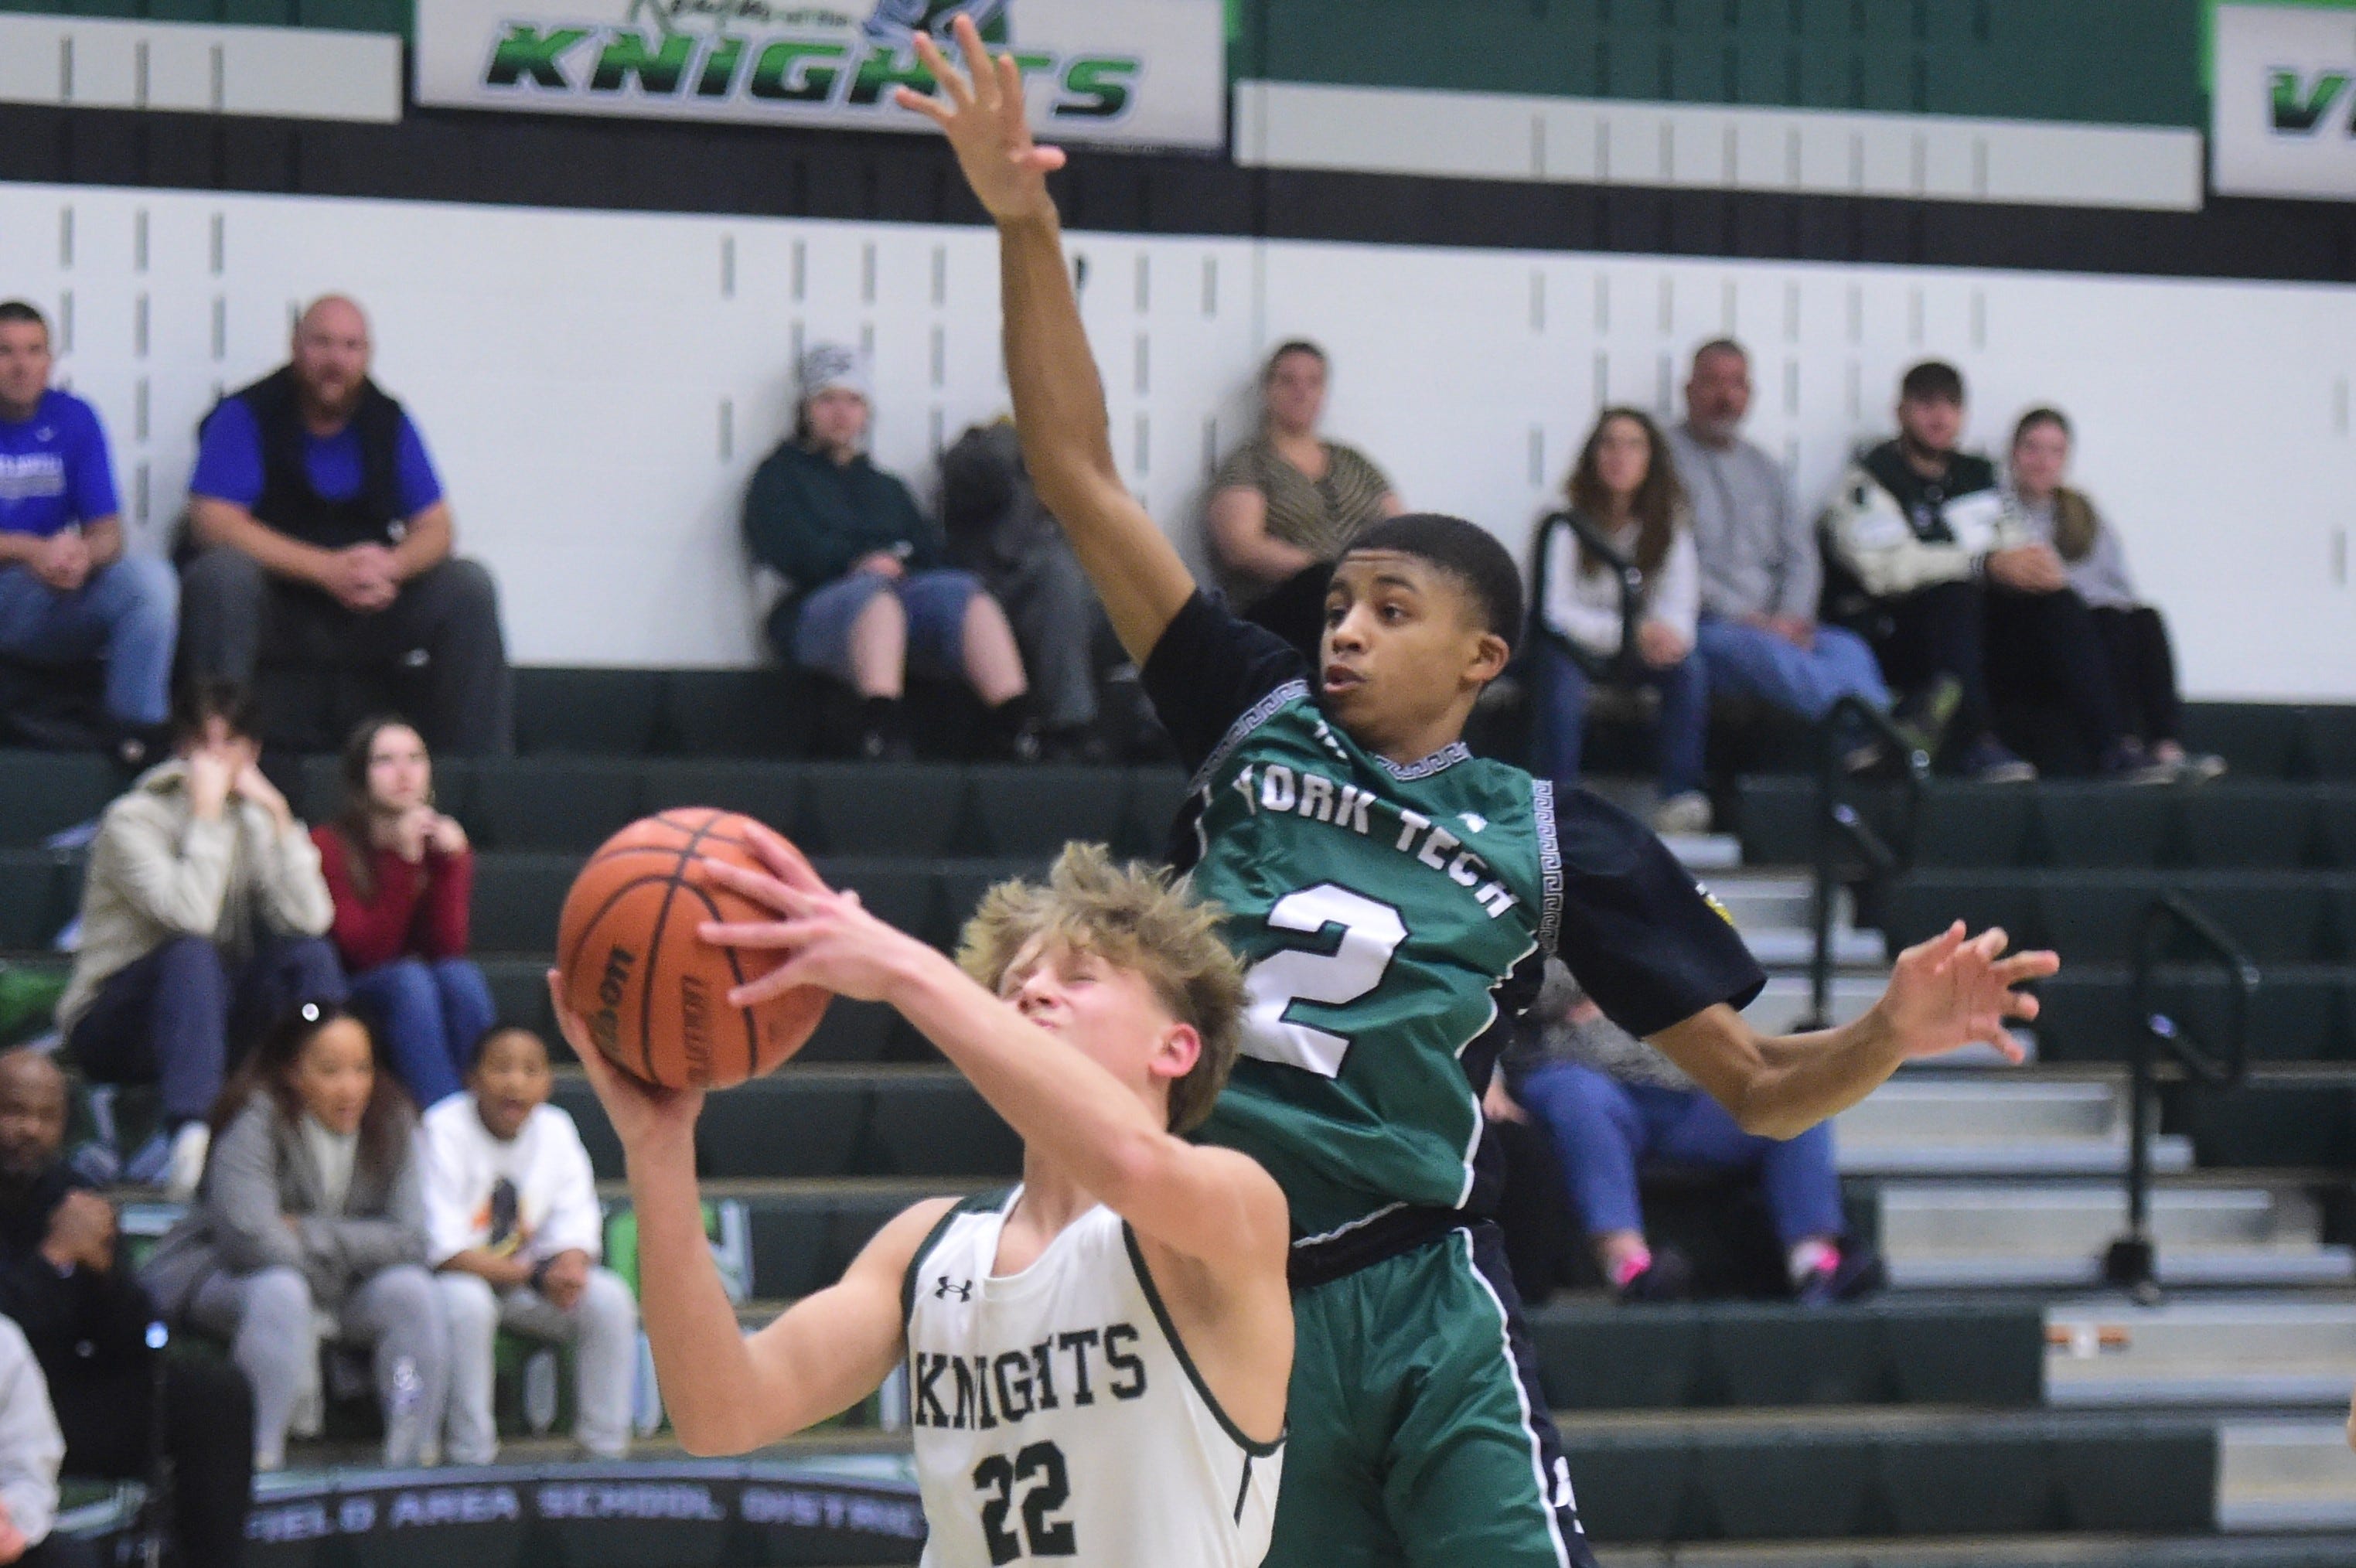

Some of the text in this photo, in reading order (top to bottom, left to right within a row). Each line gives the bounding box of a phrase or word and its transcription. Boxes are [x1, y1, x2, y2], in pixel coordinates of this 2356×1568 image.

[484, 25, 1138, 115] KNIGHS
[1233, 762, 1520, 919] YORK TECH
[1239, 882, 1410, 1079] 2
[971, 1439, 1078, 1566] 22
